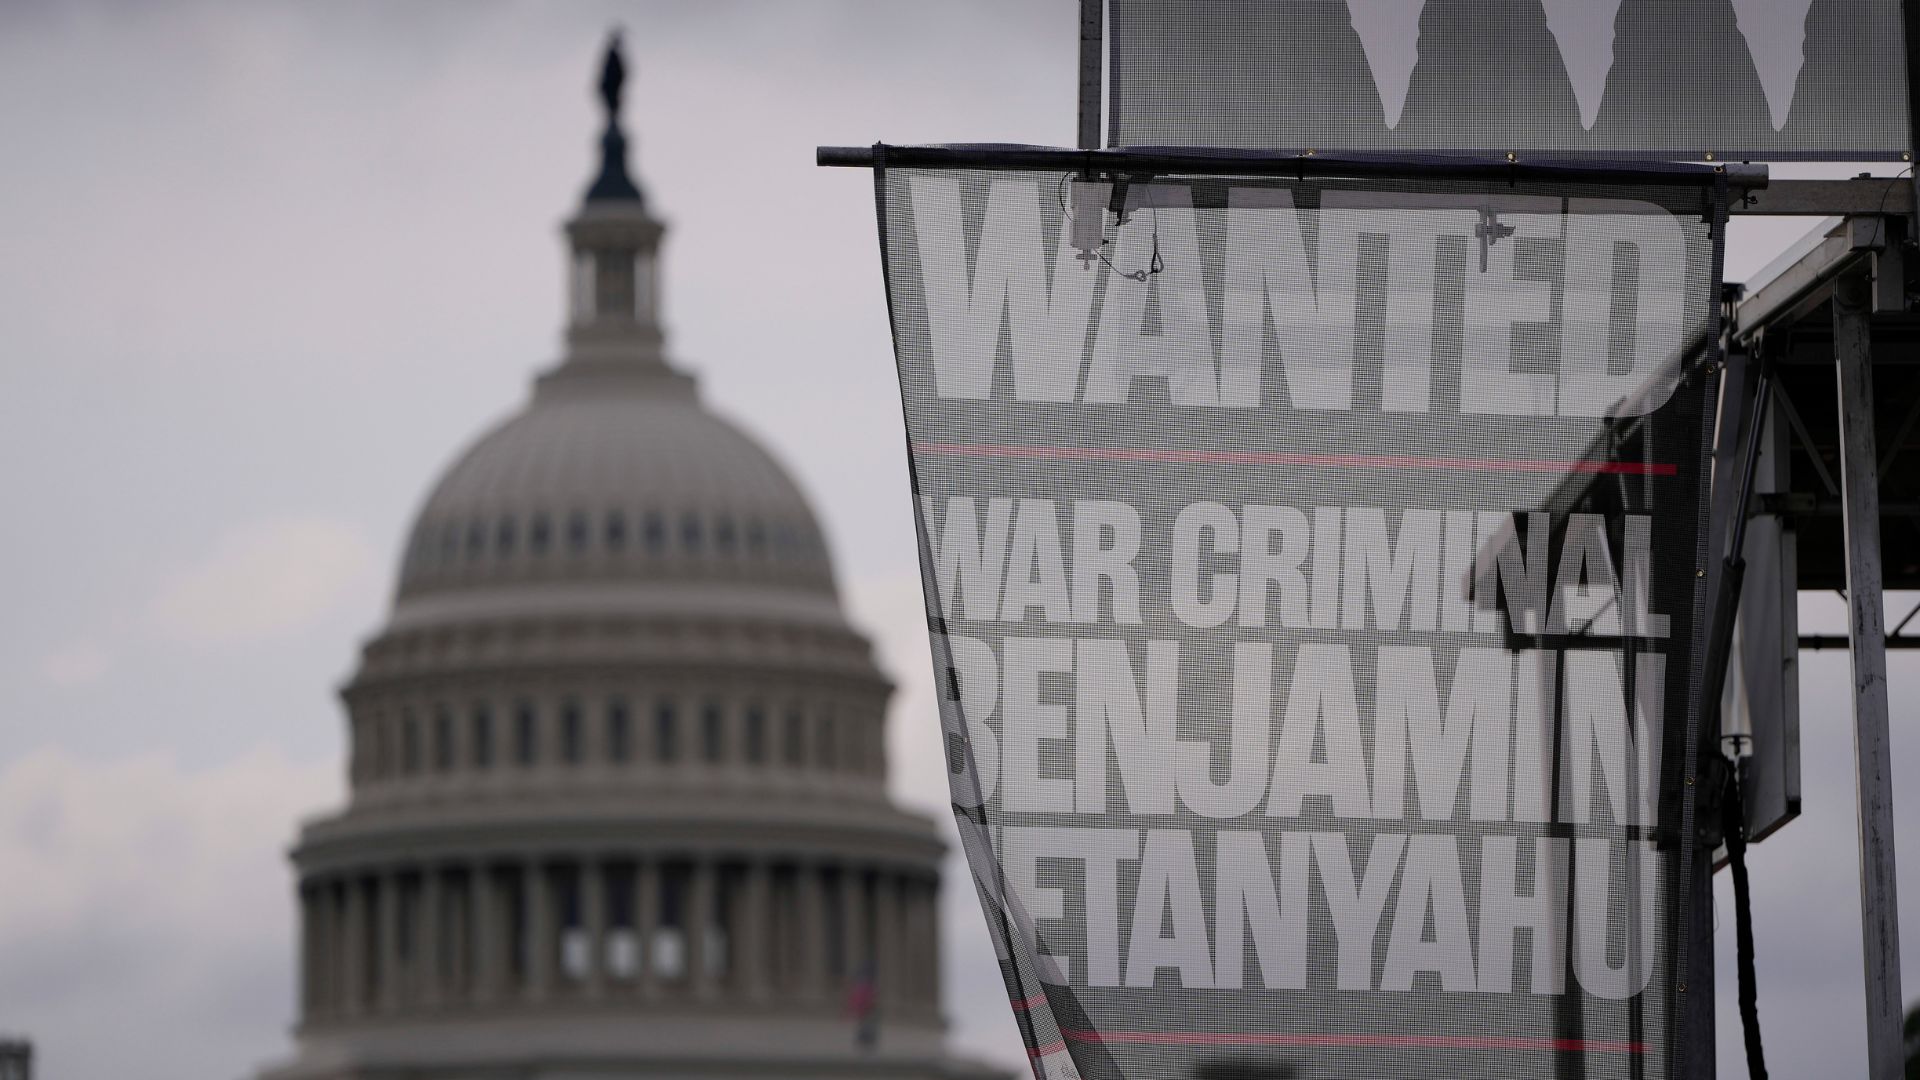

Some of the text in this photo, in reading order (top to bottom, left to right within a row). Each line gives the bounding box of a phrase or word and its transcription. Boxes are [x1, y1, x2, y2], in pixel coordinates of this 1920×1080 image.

[911, 175, 1686, 418] WANTED
[917, 495, 1671, 638] WAR CRIMINAL
[936, 635, 1667, 827] BENJAMIN
[982, 826, 1658, 1000] ETANYAHU
